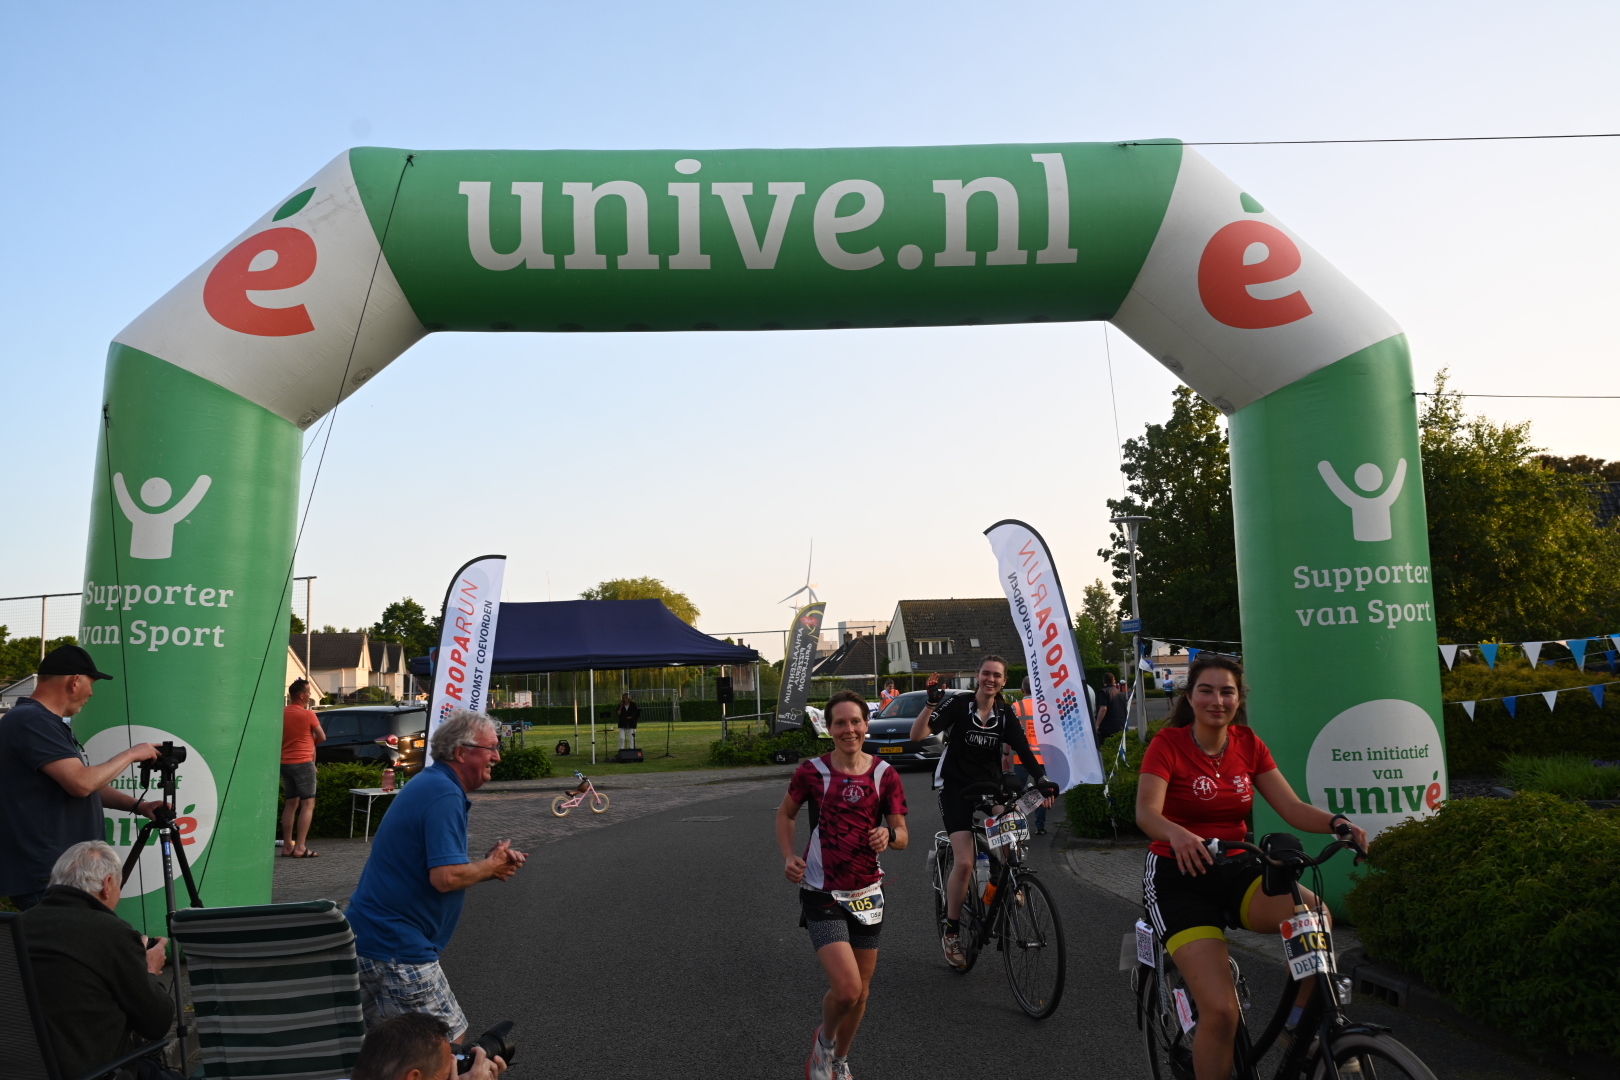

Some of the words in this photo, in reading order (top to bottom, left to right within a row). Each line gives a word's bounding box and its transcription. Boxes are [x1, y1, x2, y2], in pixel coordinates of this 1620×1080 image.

[458, 152, 1079, 272] unive.nl
[1293, 561, 1429, 593] Supporter
[85, 580, 235, 611] Supporter
[1295, 604, 1359, 627] van
[1367, 599, 1432, 629] Sport
[82, 624, 120, 645] van
[129, 619, 226, 652] Sport
[445, 578, 479, 701] ROPARUN
[476, 599, 493, 664] COEVORDEN
[469, 666, 484, 713] RKOMST
[1331, 748, 1363, 762] Een
[1367, 743, 1430, 761] initiatief
[1372, 768, 1404, 780] van
[1323, 769, 1442, 815] univé
[848, 897, 874, 912] 105
[1299, 932, 1328, 952] 105
[1293, 954, 1325, 976] DELA
